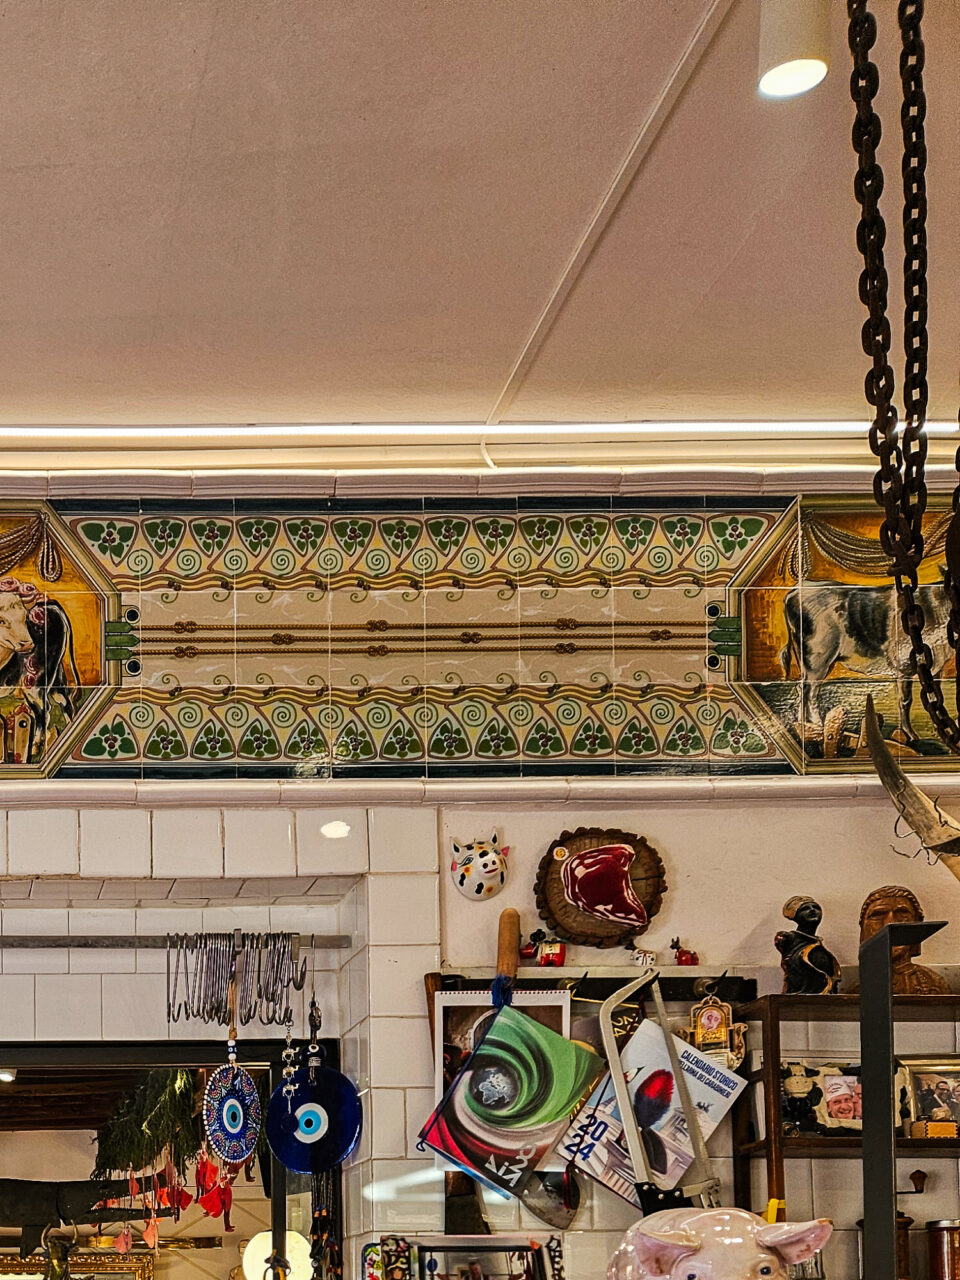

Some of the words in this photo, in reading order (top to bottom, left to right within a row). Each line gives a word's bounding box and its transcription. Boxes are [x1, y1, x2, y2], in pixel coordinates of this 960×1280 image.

[680, 1050, 716, 1079] CALENDARIO
[712, 1070, 740, 1091] STORICO
[704, 1077, 732, 1099] CARABINIERI
[577, 1113, 609, 1142] 20
[564, 1133, 596, 1161] 24
